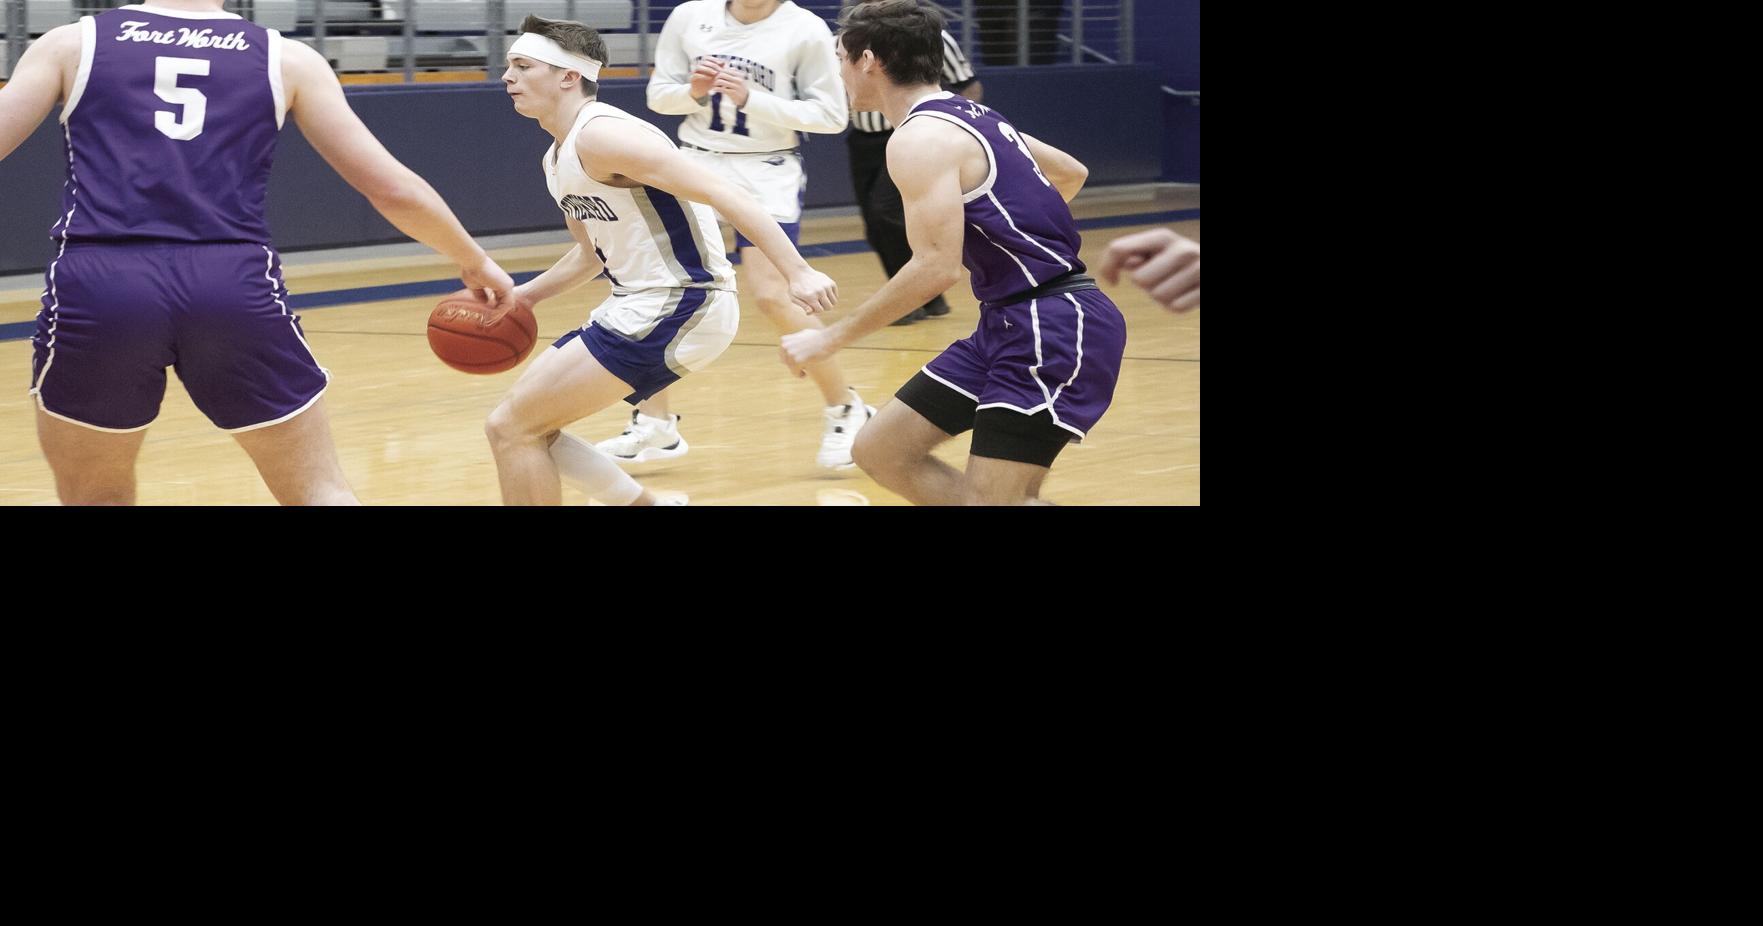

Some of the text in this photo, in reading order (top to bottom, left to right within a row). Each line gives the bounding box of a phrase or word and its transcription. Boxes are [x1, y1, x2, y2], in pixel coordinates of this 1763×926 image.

[115, 20, 250, 51] Fort Worth
[153, 56, 211, 141] 5
